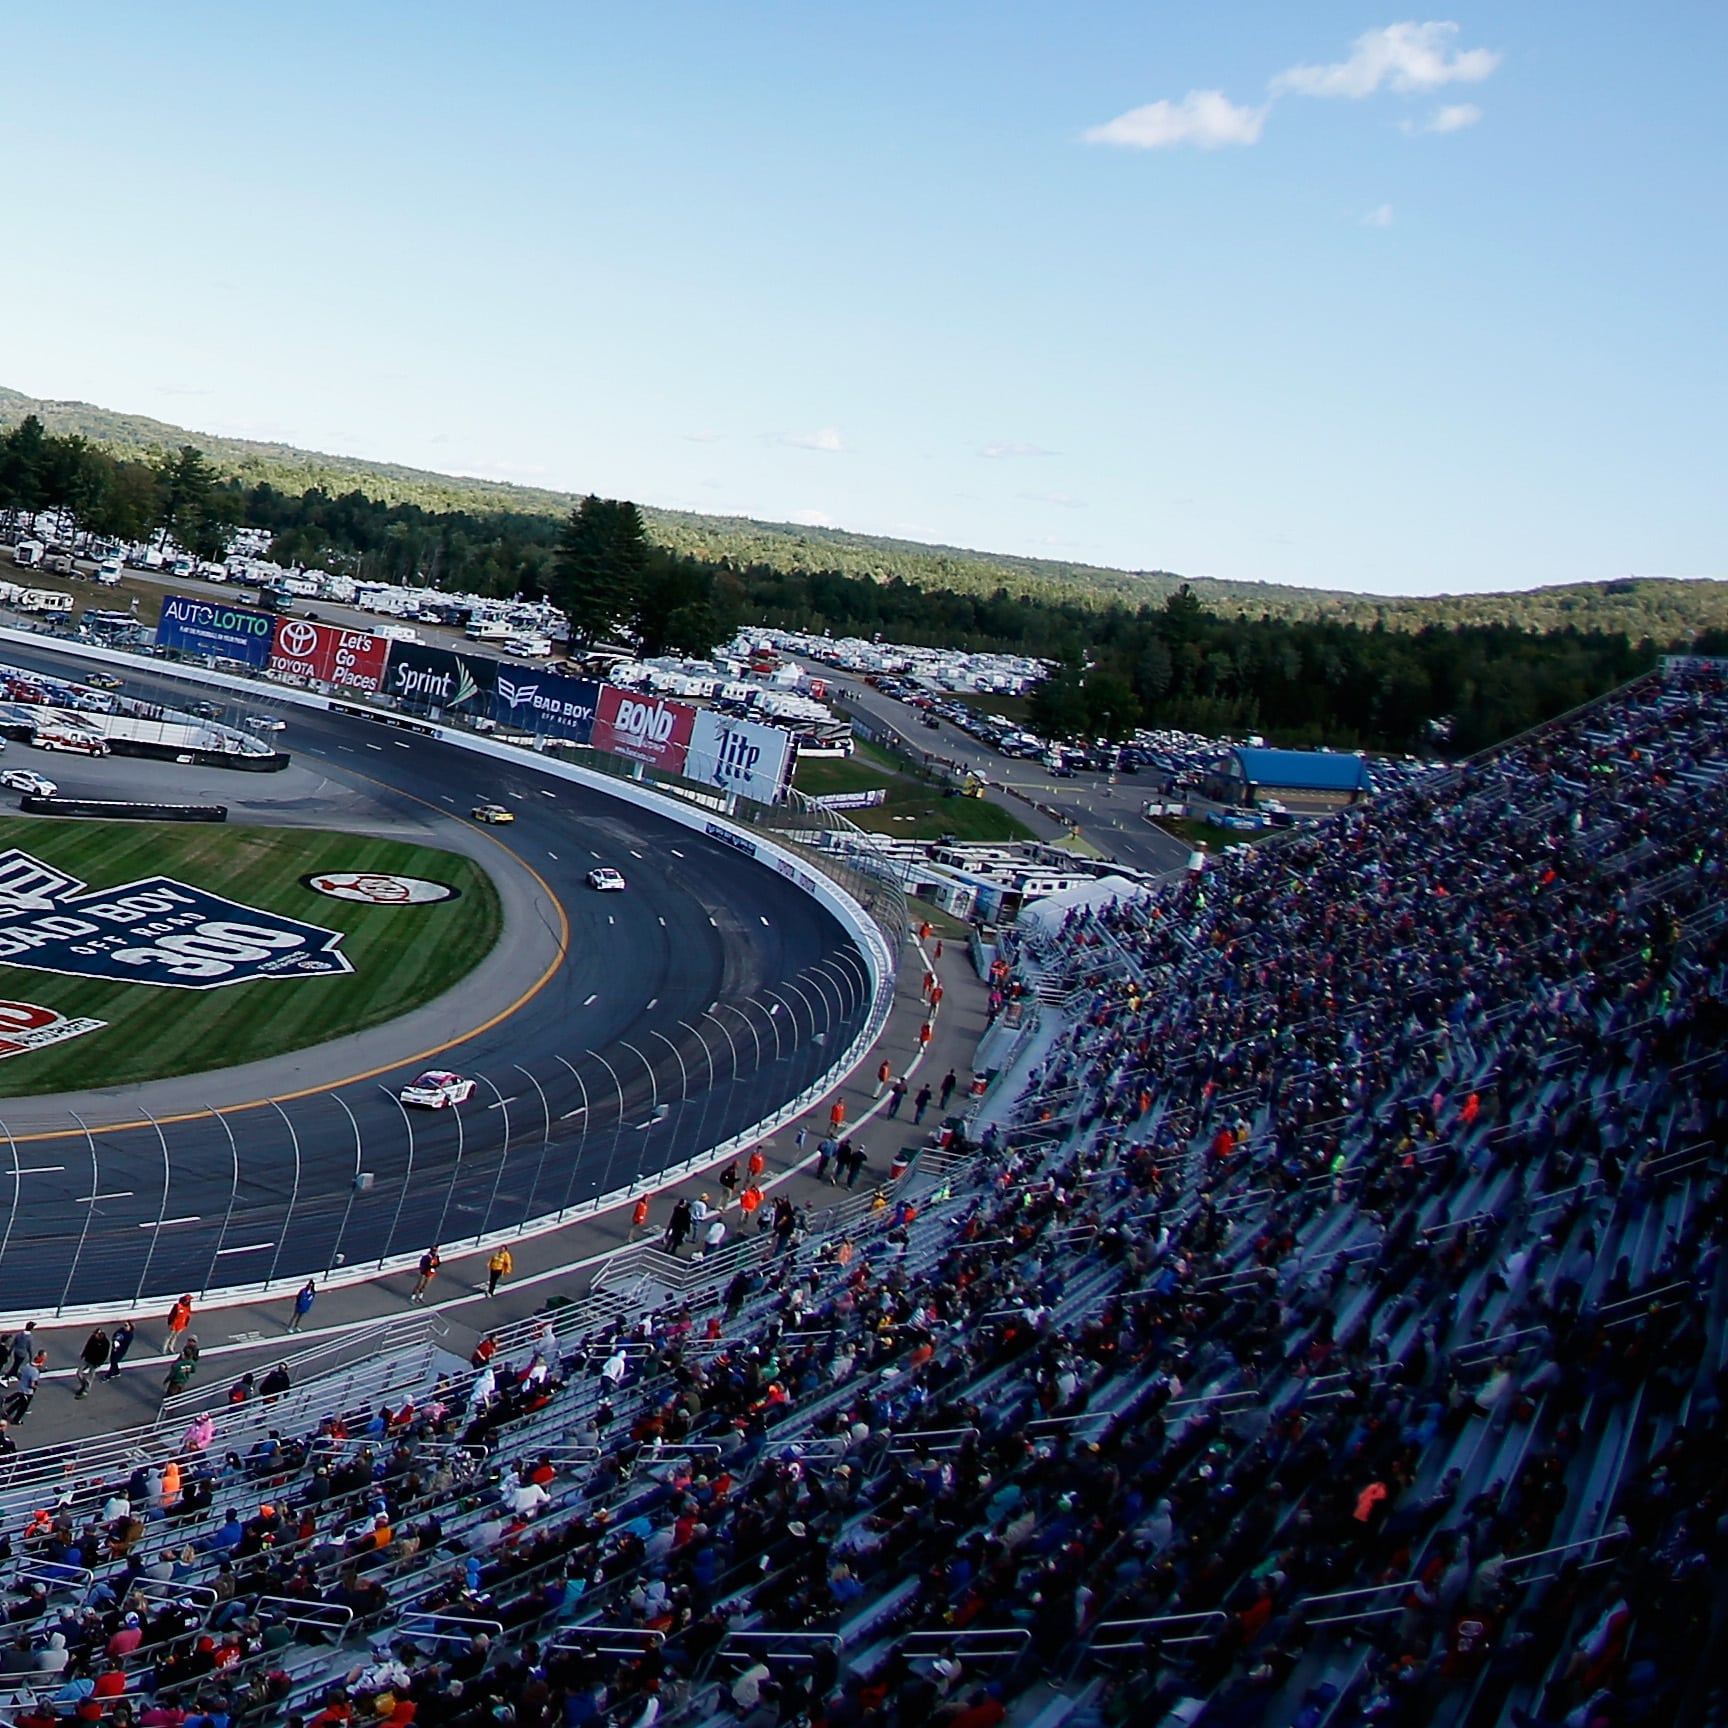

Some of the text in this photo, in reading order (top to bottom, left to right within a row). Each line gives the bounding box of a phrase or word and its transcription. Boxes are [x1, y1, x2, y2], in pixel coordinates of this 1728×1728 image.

[165, 601, 268, 637] AUTOLOTTO
[336, 649, 355, 667] Go
[338, 631, 372, 651] Let's
[271, 655, 315, 677] TOYOTA
[332, 665, 378, 690] Places
[395, 662, 451, 698] Sprint
[532, 696, 594, 720] BAD BOY
[614, 699, 674, 743] BOND
[78, 887, 197, 923] BOY
[69, 912, 207, 956] OFF ROAD
[110, 921, 306, 978] 300
